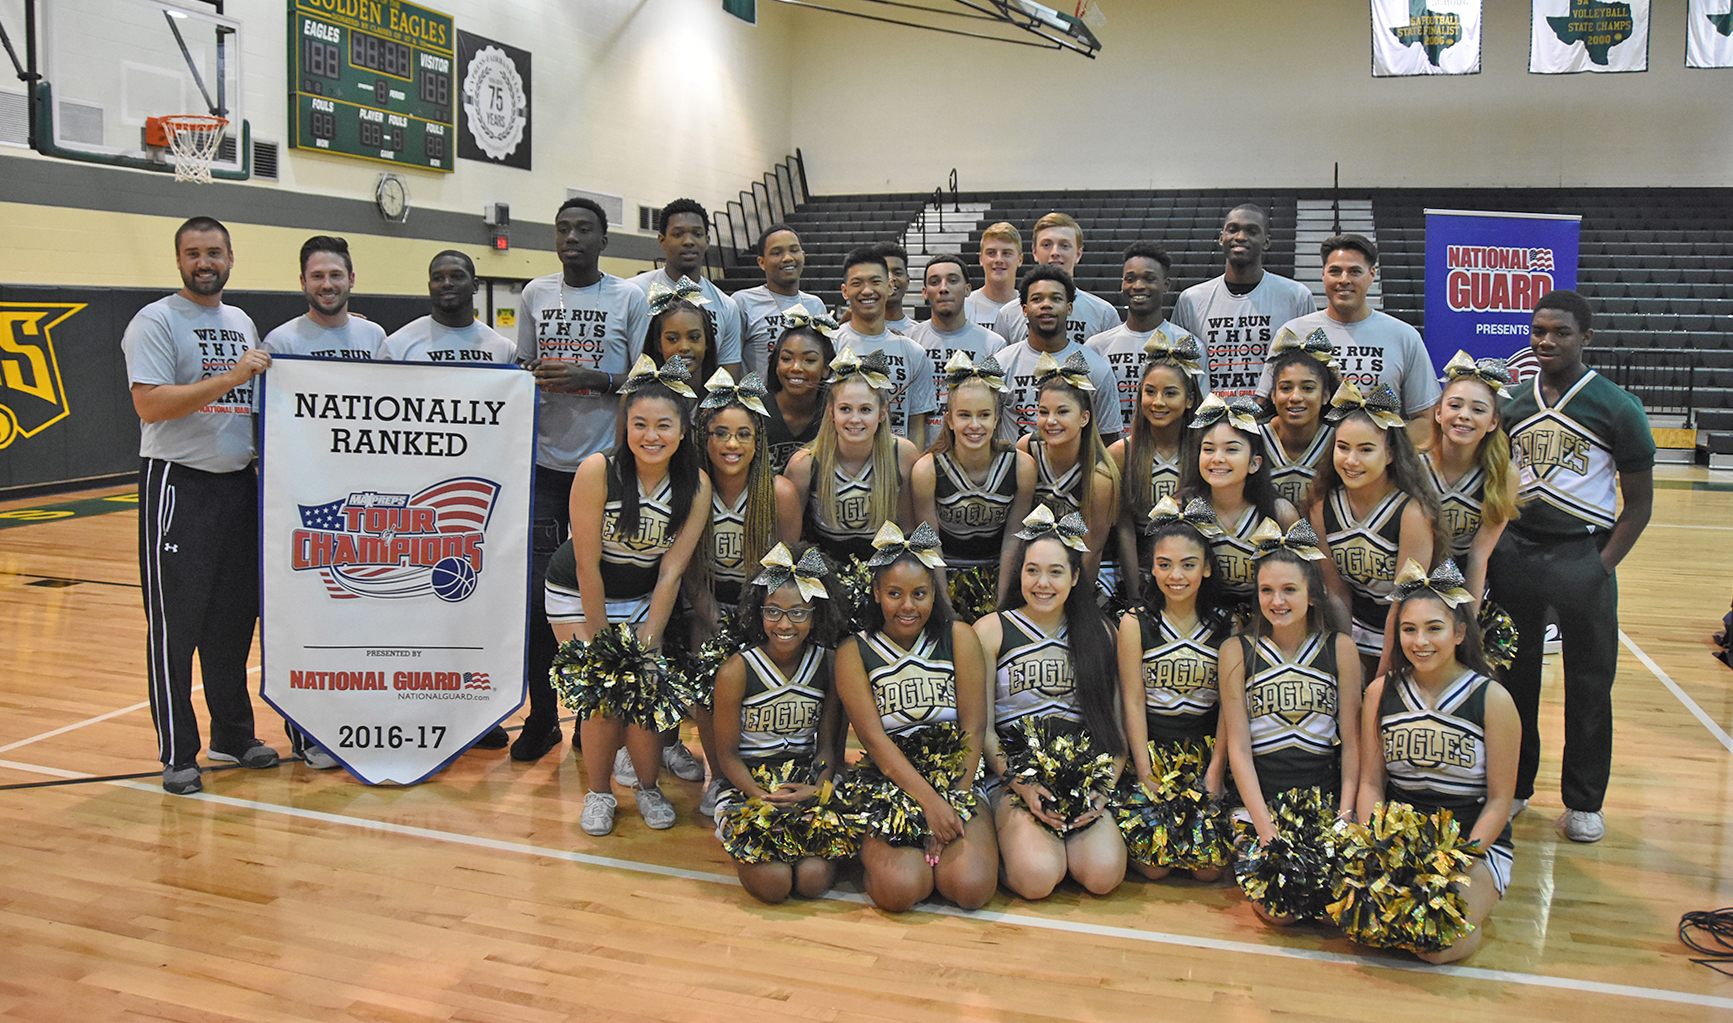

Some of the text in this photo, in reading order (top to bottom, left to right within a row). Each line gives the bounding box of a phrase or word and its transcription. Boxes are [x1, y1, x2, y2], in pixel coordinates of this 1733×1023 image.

[1422, 15, 1460, 25] FOOTBALL
[1573, 8, 1628, 18] VOLLEYBALL
[308, 0, 381, 24] LDEN
[390, 8, 447, 45] EAGLES
[1568, 21, 1631, 32] STATE CHAMPS
[304, 20, 341, 43] EAGLES
[1397, 26, 1460, 37] STATE FINALIST
[1587, 35, 1611, 45] 2000
[420, 52, 449, 73] VISITOR
[311, 98, 335, 112] FOULS
[488, 85, 504, 112] 75
[359, 108, 408, 128] PLAYER FOULS
[486, 112, 506, 128] YEARS
[426, 122, 445, 136] FOULS
[1448, 246, 1530, 270] NATIONAL
[1447, 270, 1554, 312] GUARD
[542, 309, 608, 322] WE RUN
[1208, 315, 1271, 329] WE RUN
[539, 322, 606, 338] THIS
[1066, 320, 1087, 332] UN
[1476, 323, 1530, 335] PRESENTS
[193, 329, 246, 343] WE RUN
[1207, 328, 1271, 343] THIS
[539, 338, 604, 354] SCHOOL
[1207, 343, 1268, 358] SCHOOL
[1331, 346, 1384, 358] E RUN
[428, 350, 493, 361] WE RUN
[945, 349, 976, 362] RN
[1108, 353, 1134, 365] WE
[202, 358, 238, 371] SCHO
[1335, 359, 1384, 373] HIS
[1209, 372, 1262, 388] STAT
[217, 388, 252, 404] ATE
[1211, 390, 1237, 398] TIONAL
[295, 393, 506, 425] NATIONALLY
[330, 428, 468, 457] RANKED
[350, 492, 408, 507] MAXPREPS
[342, 507, 437, 533] TOUR
[940, 503, 1005, 526] EAGLE
[381, 523, 396, 546] of
[292, 529, 484, 571] CHAMPIONS
[1332, 547, 1396, 581] AGLES
[366, 650, 422, 658] PRESENTED BY
[289, 670, 461, 691] NATIONAL GUARD
[1008, 659, 1076, 697] EAGL
[1143, 659, 1218, 691] EAGLE
[398, 692, 490, 701] NATIONALGUARD.com
[1249, 681, 1338, 720] EAGLES
[338, 725, 447, 749] 2016-17
[1382, 728, 1476, 769] EAGLES
